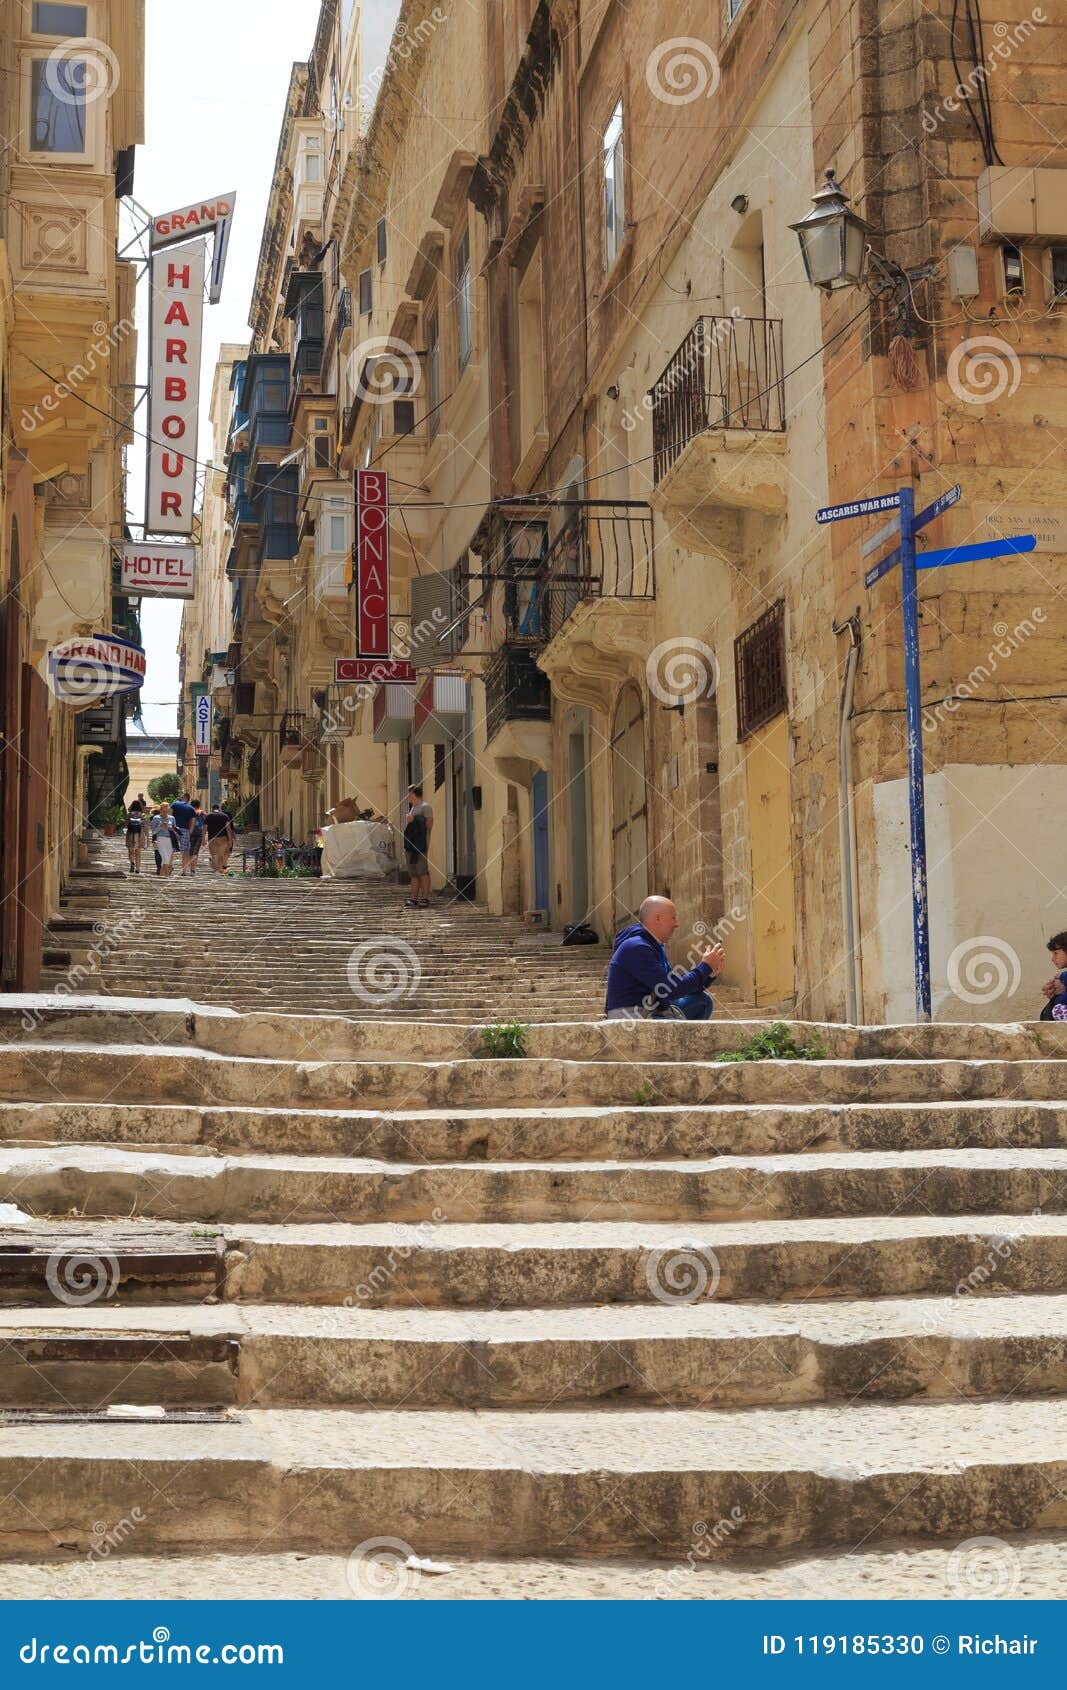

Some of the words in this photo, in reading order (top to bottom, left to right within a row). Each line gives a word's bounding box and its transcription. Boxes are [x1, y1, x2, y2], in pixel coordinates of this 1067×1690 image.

[156, 202, 231, 235] GRAND
[161, 263, 190, 518] HARBOUR
[816, 504, 859, 521] LASCARIS
[860, 500, 880, 513] WAR
[881, 495, 900, 509] RMS
[124, 556, 192, 577] HOTEL
[361, 475, 386, 649] BONACI
[57, 641, 121, 664] GRAND
[198, 696, 209, 743] ASTI
